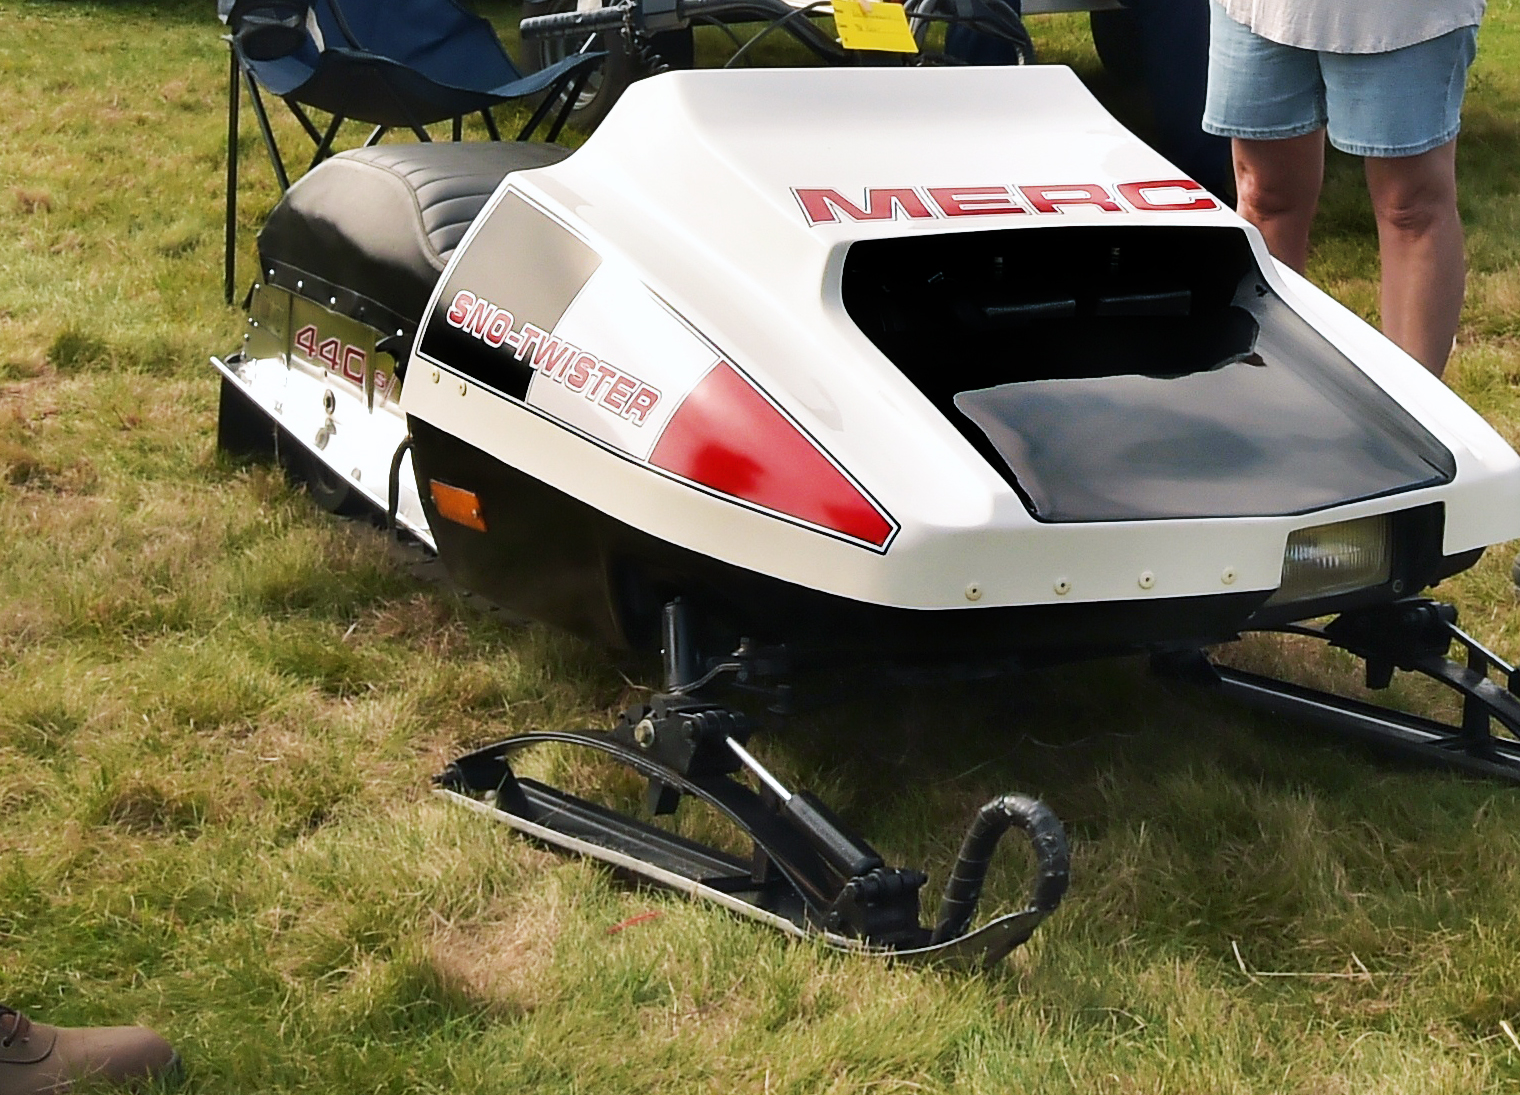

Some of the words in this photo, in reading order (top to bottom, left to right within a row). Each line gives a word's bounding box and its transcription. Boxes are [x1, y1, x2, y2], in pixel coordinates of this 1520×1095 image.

[790, 179, 1222, 227] MERC
[294, 324, 366, 387] 440
[447, 290, 662, 427] SNO-TWISTER
